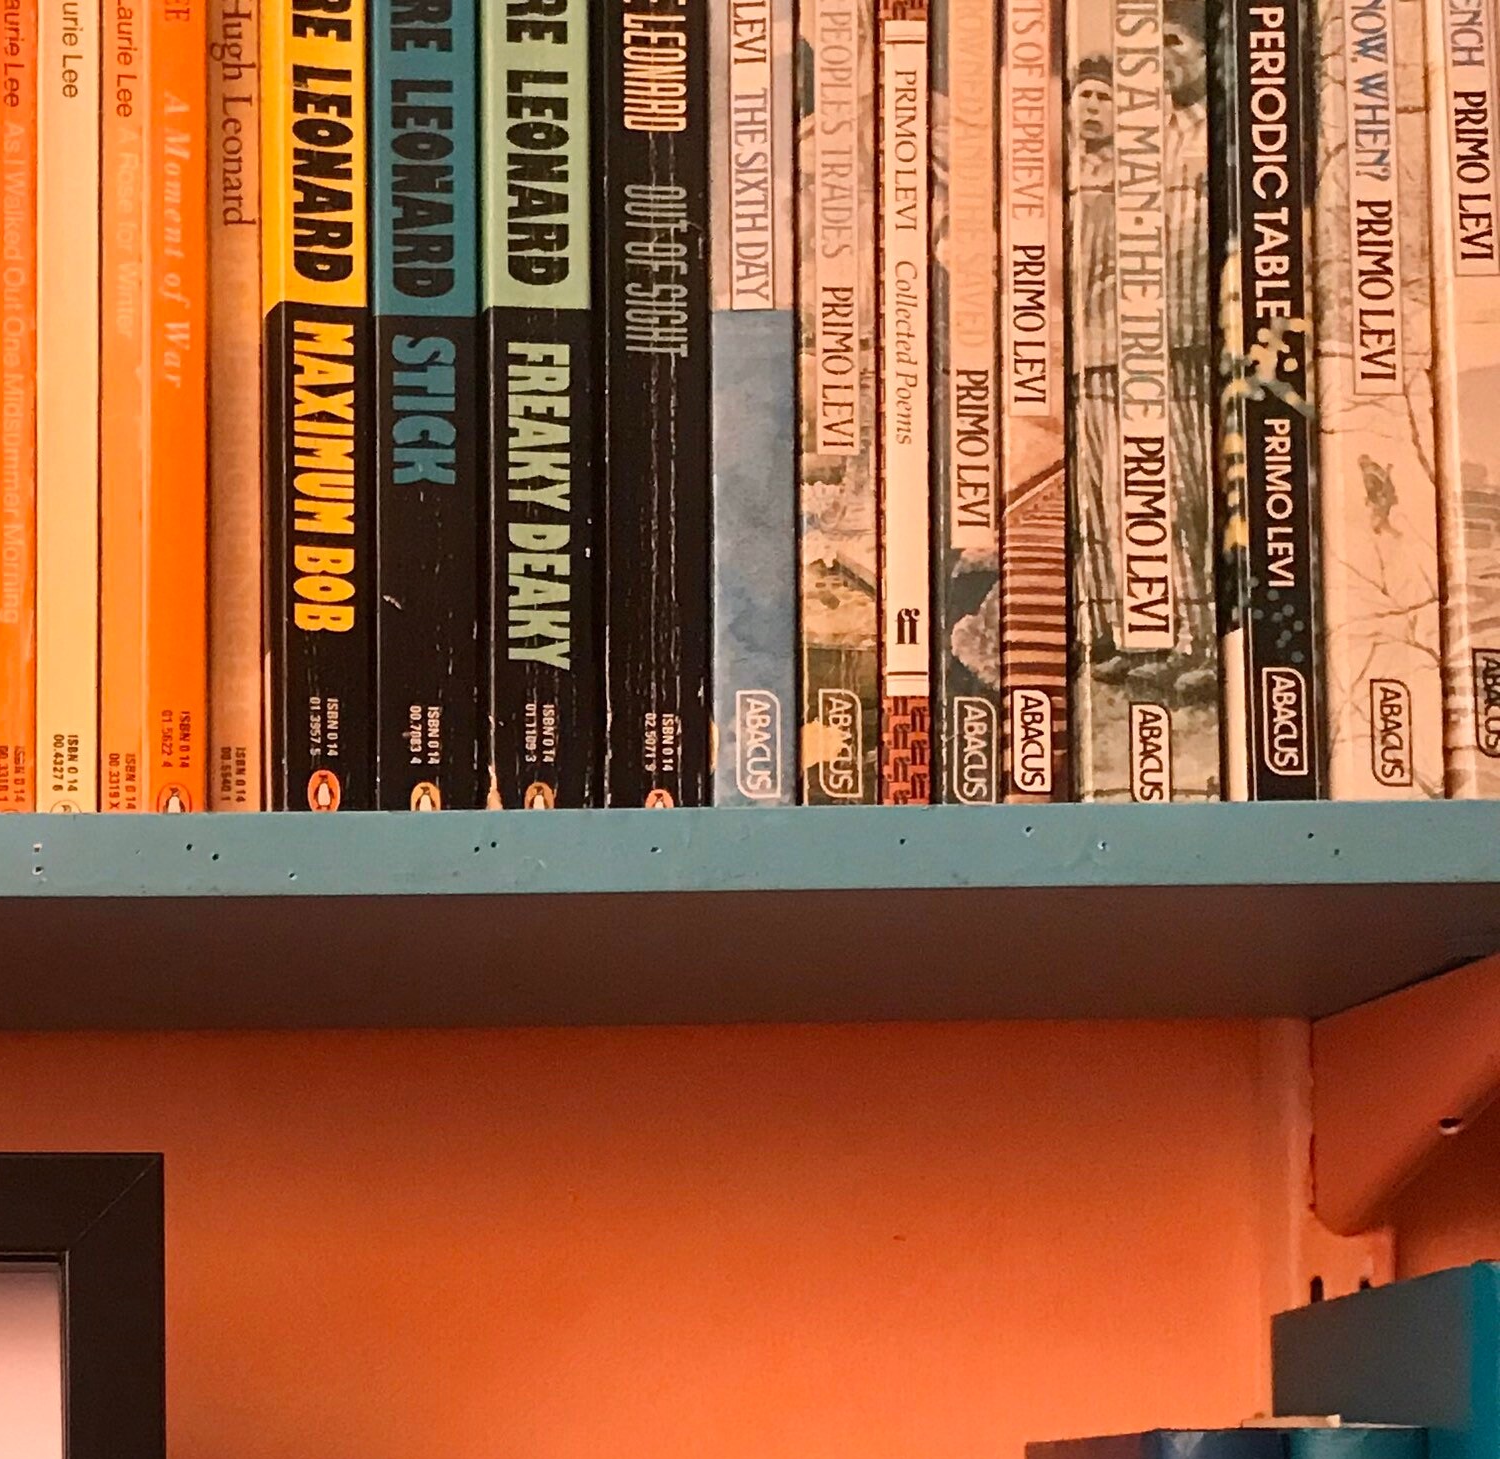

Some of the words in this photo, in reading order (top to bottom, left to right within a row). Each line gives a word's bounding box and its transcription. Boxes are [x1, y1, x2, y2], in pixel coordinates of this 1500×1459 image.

[2, 62, 25, 108] Lee
[62, 54, 84, 98] Lee
[116, 73, 139, 118] Lee
[621, 13, 688, 132] LEONARD
[819, 12, 853, 136] PEOPLE'S
[1011, 42, 1045, 79] OF
[1249, 5, 1291, 201] PERIODIC
[221, 92, 257, 227] Leonard
[731, 88, 768, 150] THE
[895, 69, 918, 163] PRIMO
[1011, 86, 1045, 220] REPRIEVE
[1354, 70, 1391, 182] WHEN?
[1454, 91, 1491, 184] PRIMO
[162, 126, 191, 259] Moment
[291, 64, 354, 283] LEONARD
[390, 79, 456, 299] LEONARD
[505, 70, 569, 287] LEONARD
[623, 184, 688, 232] OUT
[733, 152, 768, 239] SIXTH
[820, 149, 854, 259] TRADES
[894, 170, 918, 231] LEVI
[623, 242, 688, 275] OF
[734, 243, 770, 302] DAY
[1253, 206, 1292, 319] TABLE
[1357, 199, 1394, 300] PRIMO
[1458, 192, 1495, 261] LEVI
[159, 271, 192, 310] of
[623, 283, 690, 358] SIGHT
[821, 285, 854, 376] PRIMO
[895, 260, 919, 367] Collected
[1011, 245, 1045, 334] PRIMO
[162, 319, 190, 390] War
[1013, 340, 1046, 405] LEVI
[1119, 308, 1166, 421] TRUCE
[1358, 308, 1397, 382] LEVI
[2, 380, 24, 517] Midsummer
[292, 319, 355, 533] MAXIMUM
[390, 335, 457, 486] STICK
[506, 342, 570, 512] FREAKY
[821, 384, 856, 449] LEVI
[895, 372, 918, 445] Poems
[954, 369, 989, 457] PRIMO
[955, 464, 992, 530] LEVI
[1121, 435, 1167, 546] PRIMO
[1262, 418, 1295, 520] PRIMO
[0, 524, 23, 624] Morning
[293, 546, 355, 632] BOB
[506, 522, 570, 671] DEAKY
[1125, 553, 1169, 634] LEVI
[1266, 526, 1296, 588] LEVI
[66, 734, 79, 762] ISBN
[326, 697, 339, 729] ISBN
[427, 705, 440, 737] ISBN
[661, 712, 674, 745] ISBN
[744, 696, 773, 791] ABACUS
[959, 704, 988, 799] ABACUS
[1017, 694, 1047, 788] ABACUS
[1137, 709, 1167, 801] ABACUS
[1270, 675, 1300, 772] ABACUS
[1377, 686, 1405, 779] ABACUS
